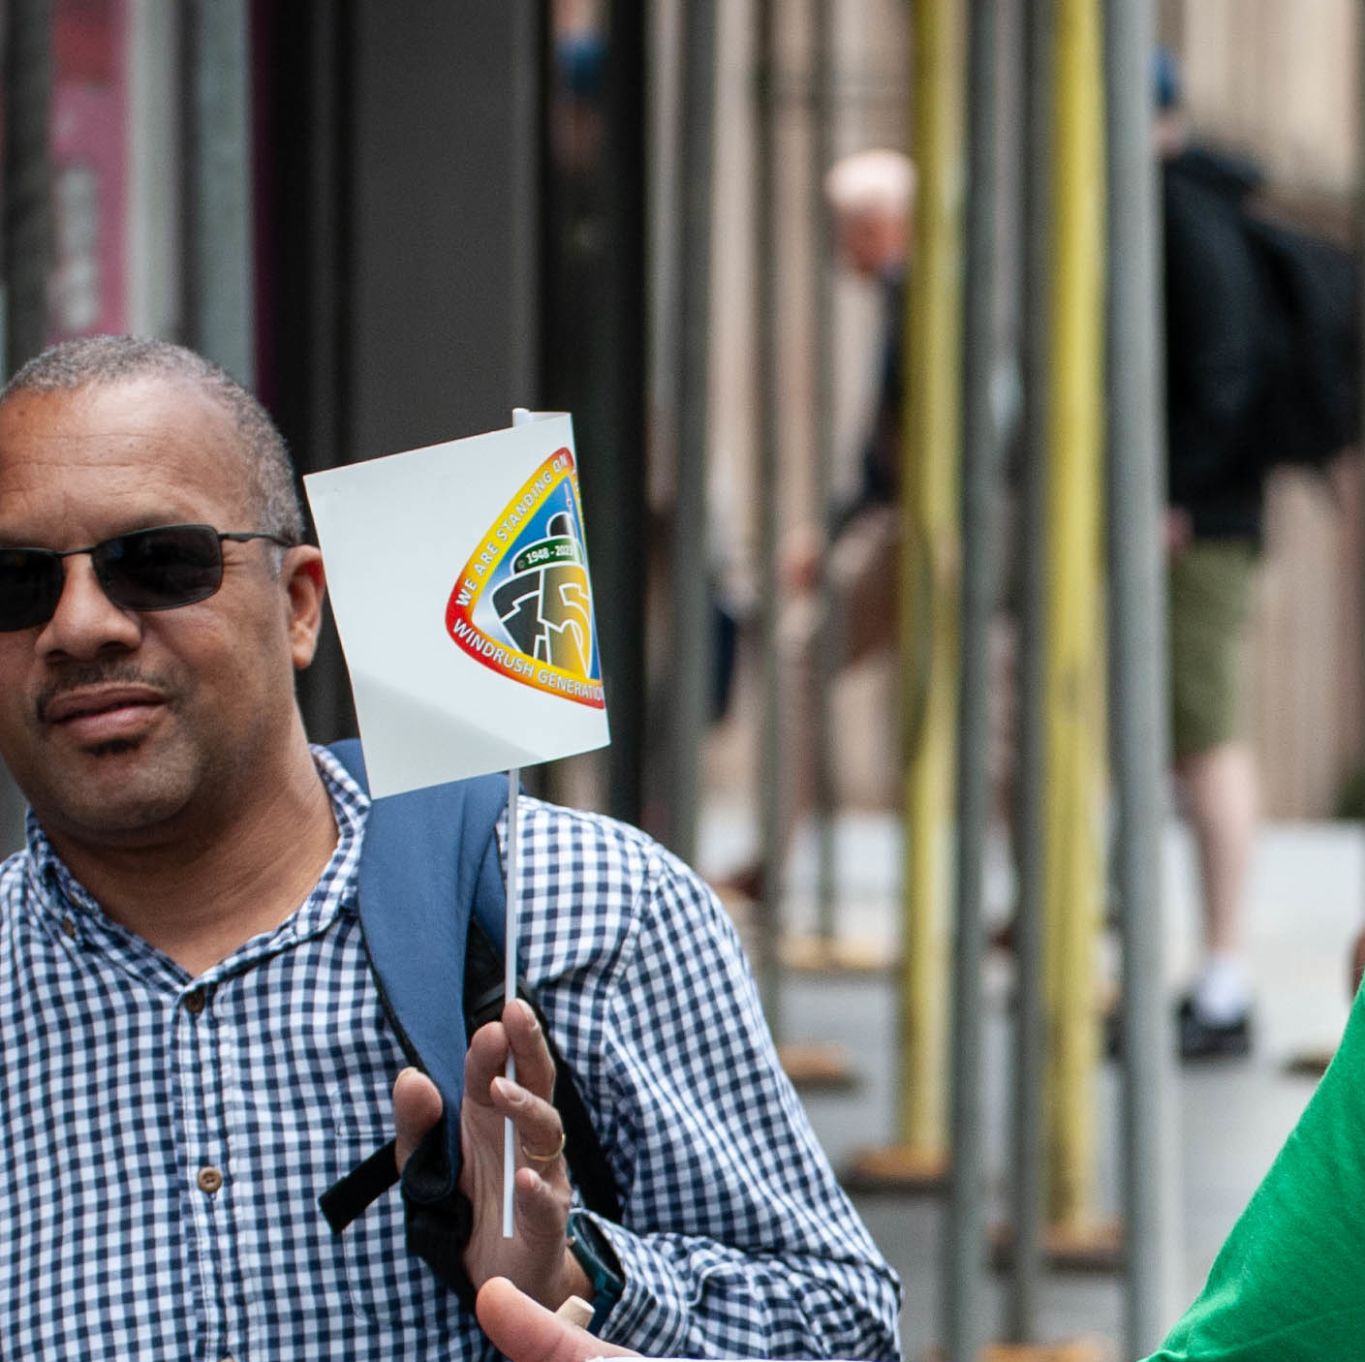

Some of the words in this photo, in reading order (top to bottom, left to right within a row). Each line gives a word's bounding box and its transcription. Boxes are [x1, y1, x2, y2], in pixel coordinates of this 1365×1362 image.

[455, 577, 477, 607] WE
[475, 543, 499, 577] ARE
[496, 471, 553, 542] STANDING
[552, 454, 570, 471] ON
[452, 618, 535, 679] WINDRUSH
